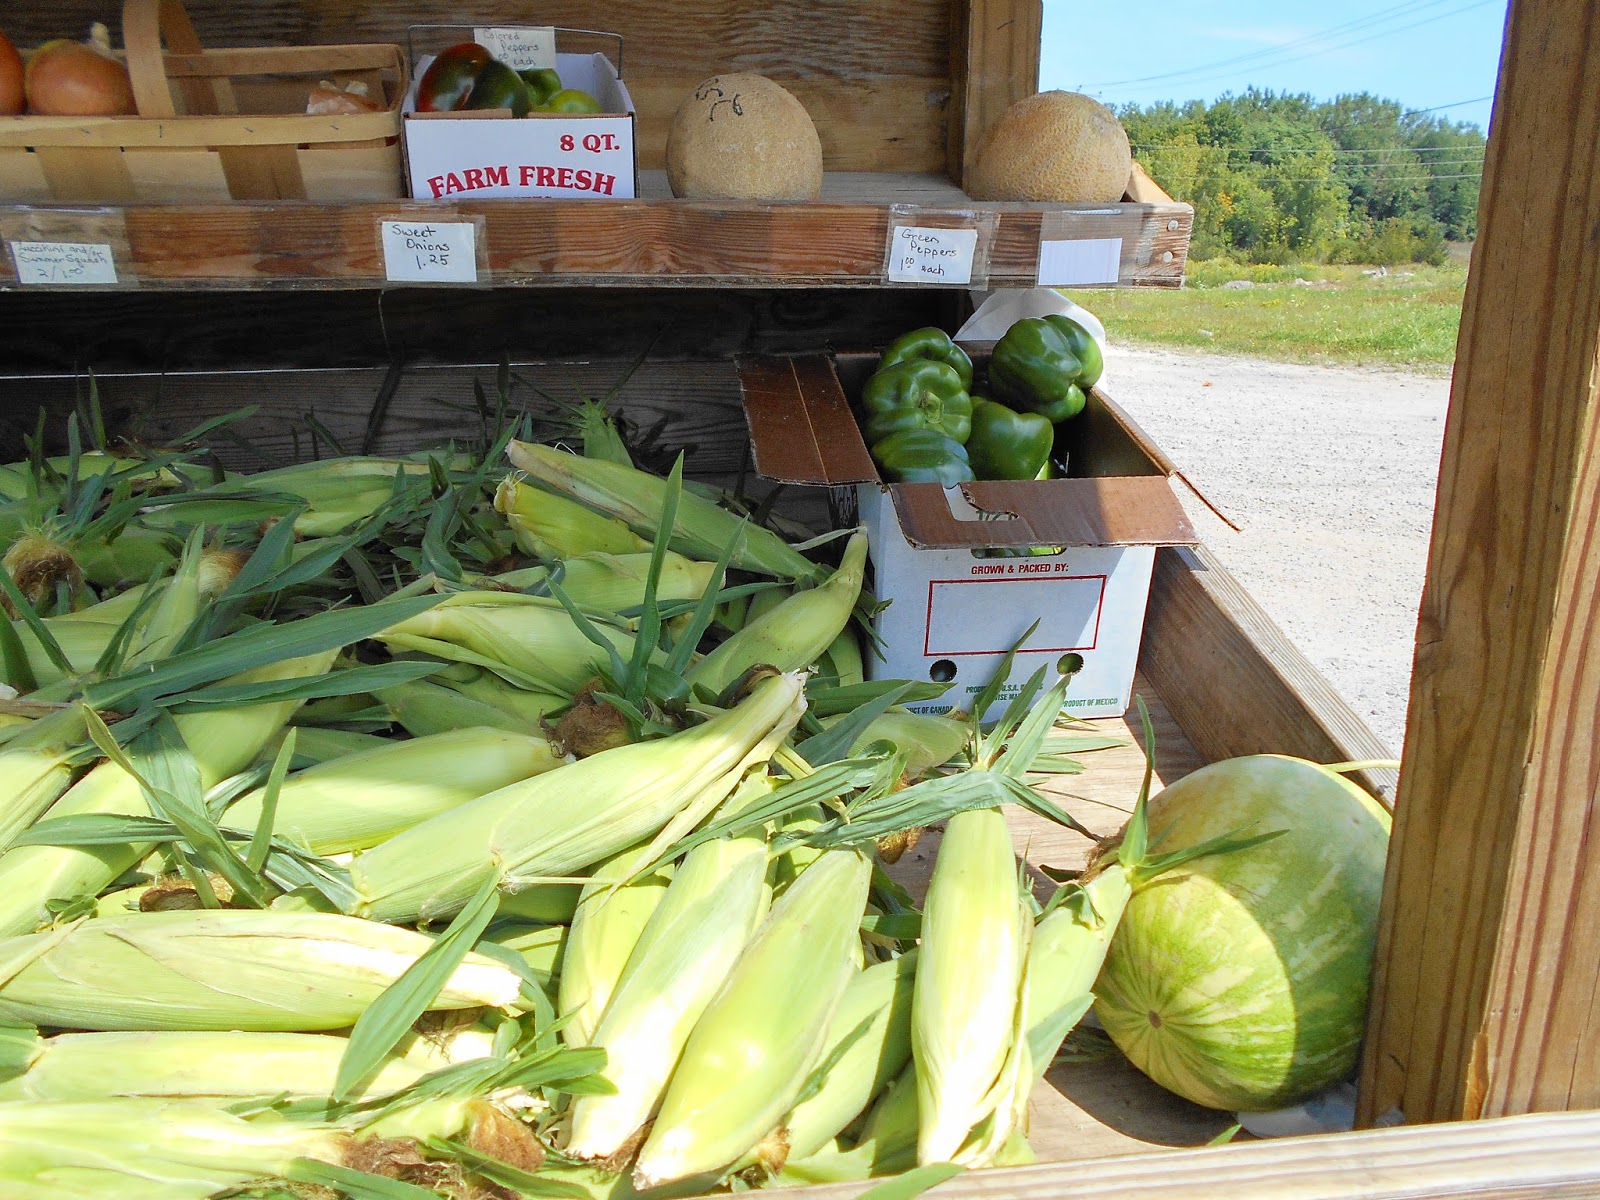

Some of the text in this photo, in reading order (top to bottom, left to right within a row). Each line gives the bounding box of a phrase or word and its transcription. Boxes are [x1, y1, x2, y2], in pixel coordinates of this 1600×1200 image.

[501, 40, 538, 54] Peppers
[513, 57, 536, 65] each
[560, 134, 620, 153] 8 QT.
[427, 165, 616, 199] FARM FRESH
[392, 224, 436, 237] Sweet
[901, 228, 940, 243] Green
[406, 238, 450, 252] Onions
[910, 240, 957, 259] Peppers
[18, 252, 108, 268] Summer Squash
[415, 254, 449, 269] 1.25
[921, 264, 945, 276] each
[971, 562, 1069, 575] GROWN & PACKED BY:
[1095, 697, 1119, 706] MEXICO
[921, 706, 930, 714] OF
